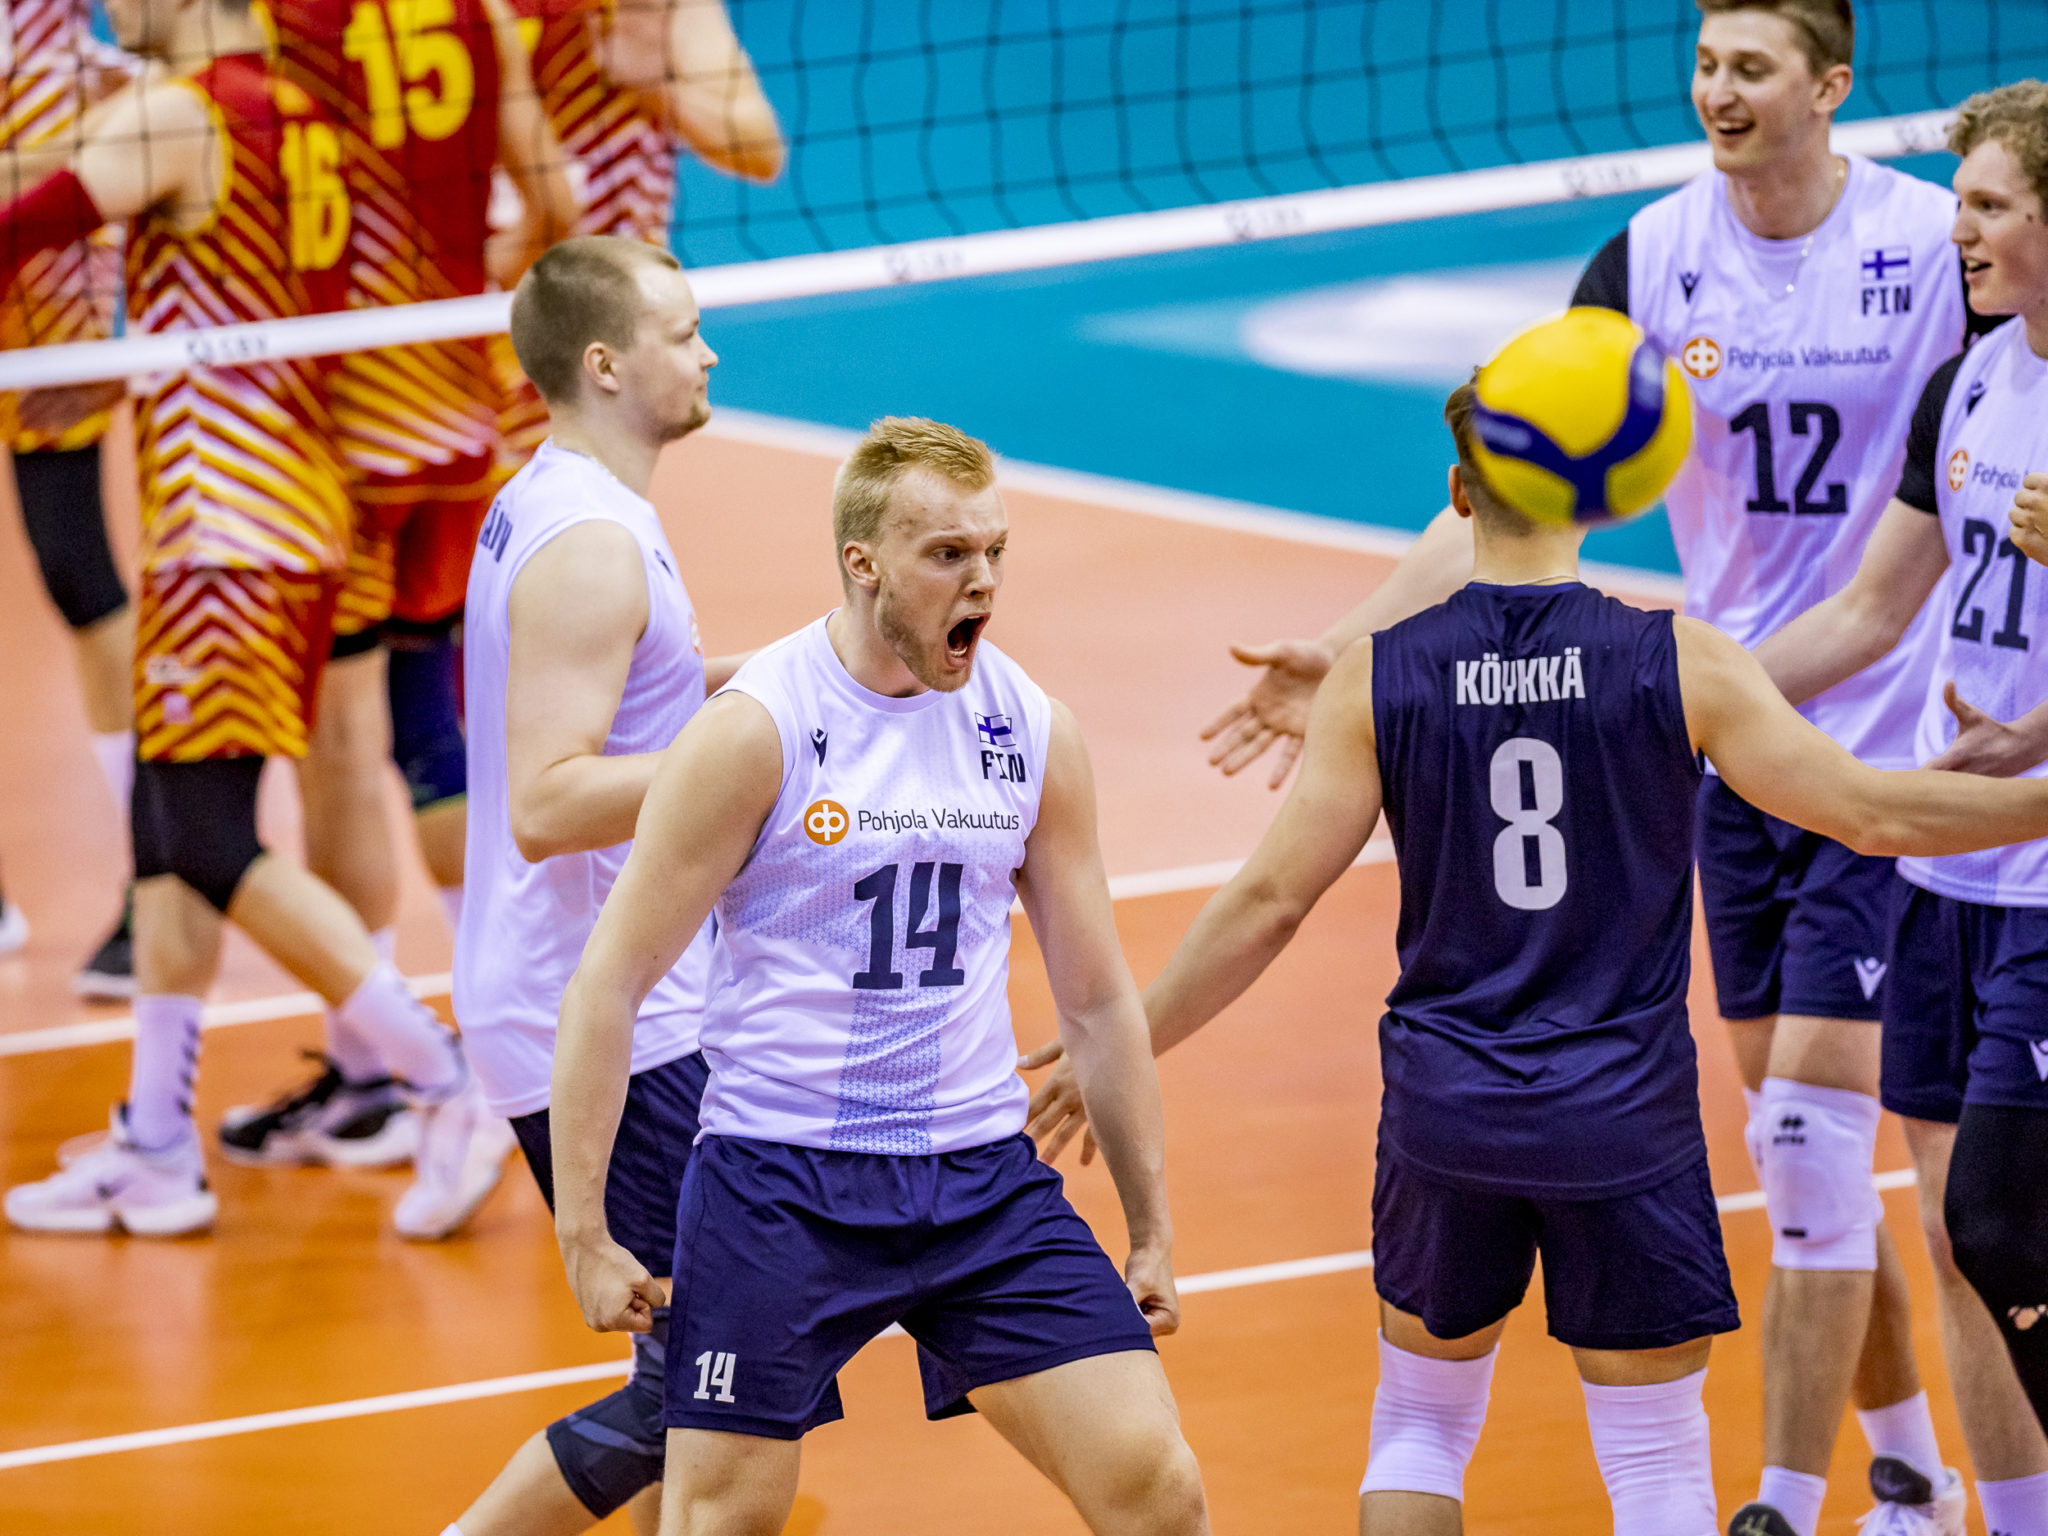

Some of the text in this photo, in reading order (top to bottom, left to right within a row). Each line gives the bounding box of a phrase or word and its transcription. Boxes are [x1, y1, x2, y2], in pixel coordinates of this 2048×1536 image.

[342, 0, 474, 149] 15
[280, 121, 350, 270] 16
[1862, 285, 1910, 315] FIN
[1727, 344, 1891, 372] Pohjola Vakuutus
[1730, 402, 1847, 514] 12
[1951, 518, 2029, 651] 21
[1456, 647, 1585, 705] KÖYKKÄ
[981, 750, 1026, 783] FIN
[858, 808, 1019, 834] Pohjola Vakuutus
[1489, 737, 1568, 911] 8
[853, 862, 965, 989] 14
[693, 1350, 736, 1403] 14
